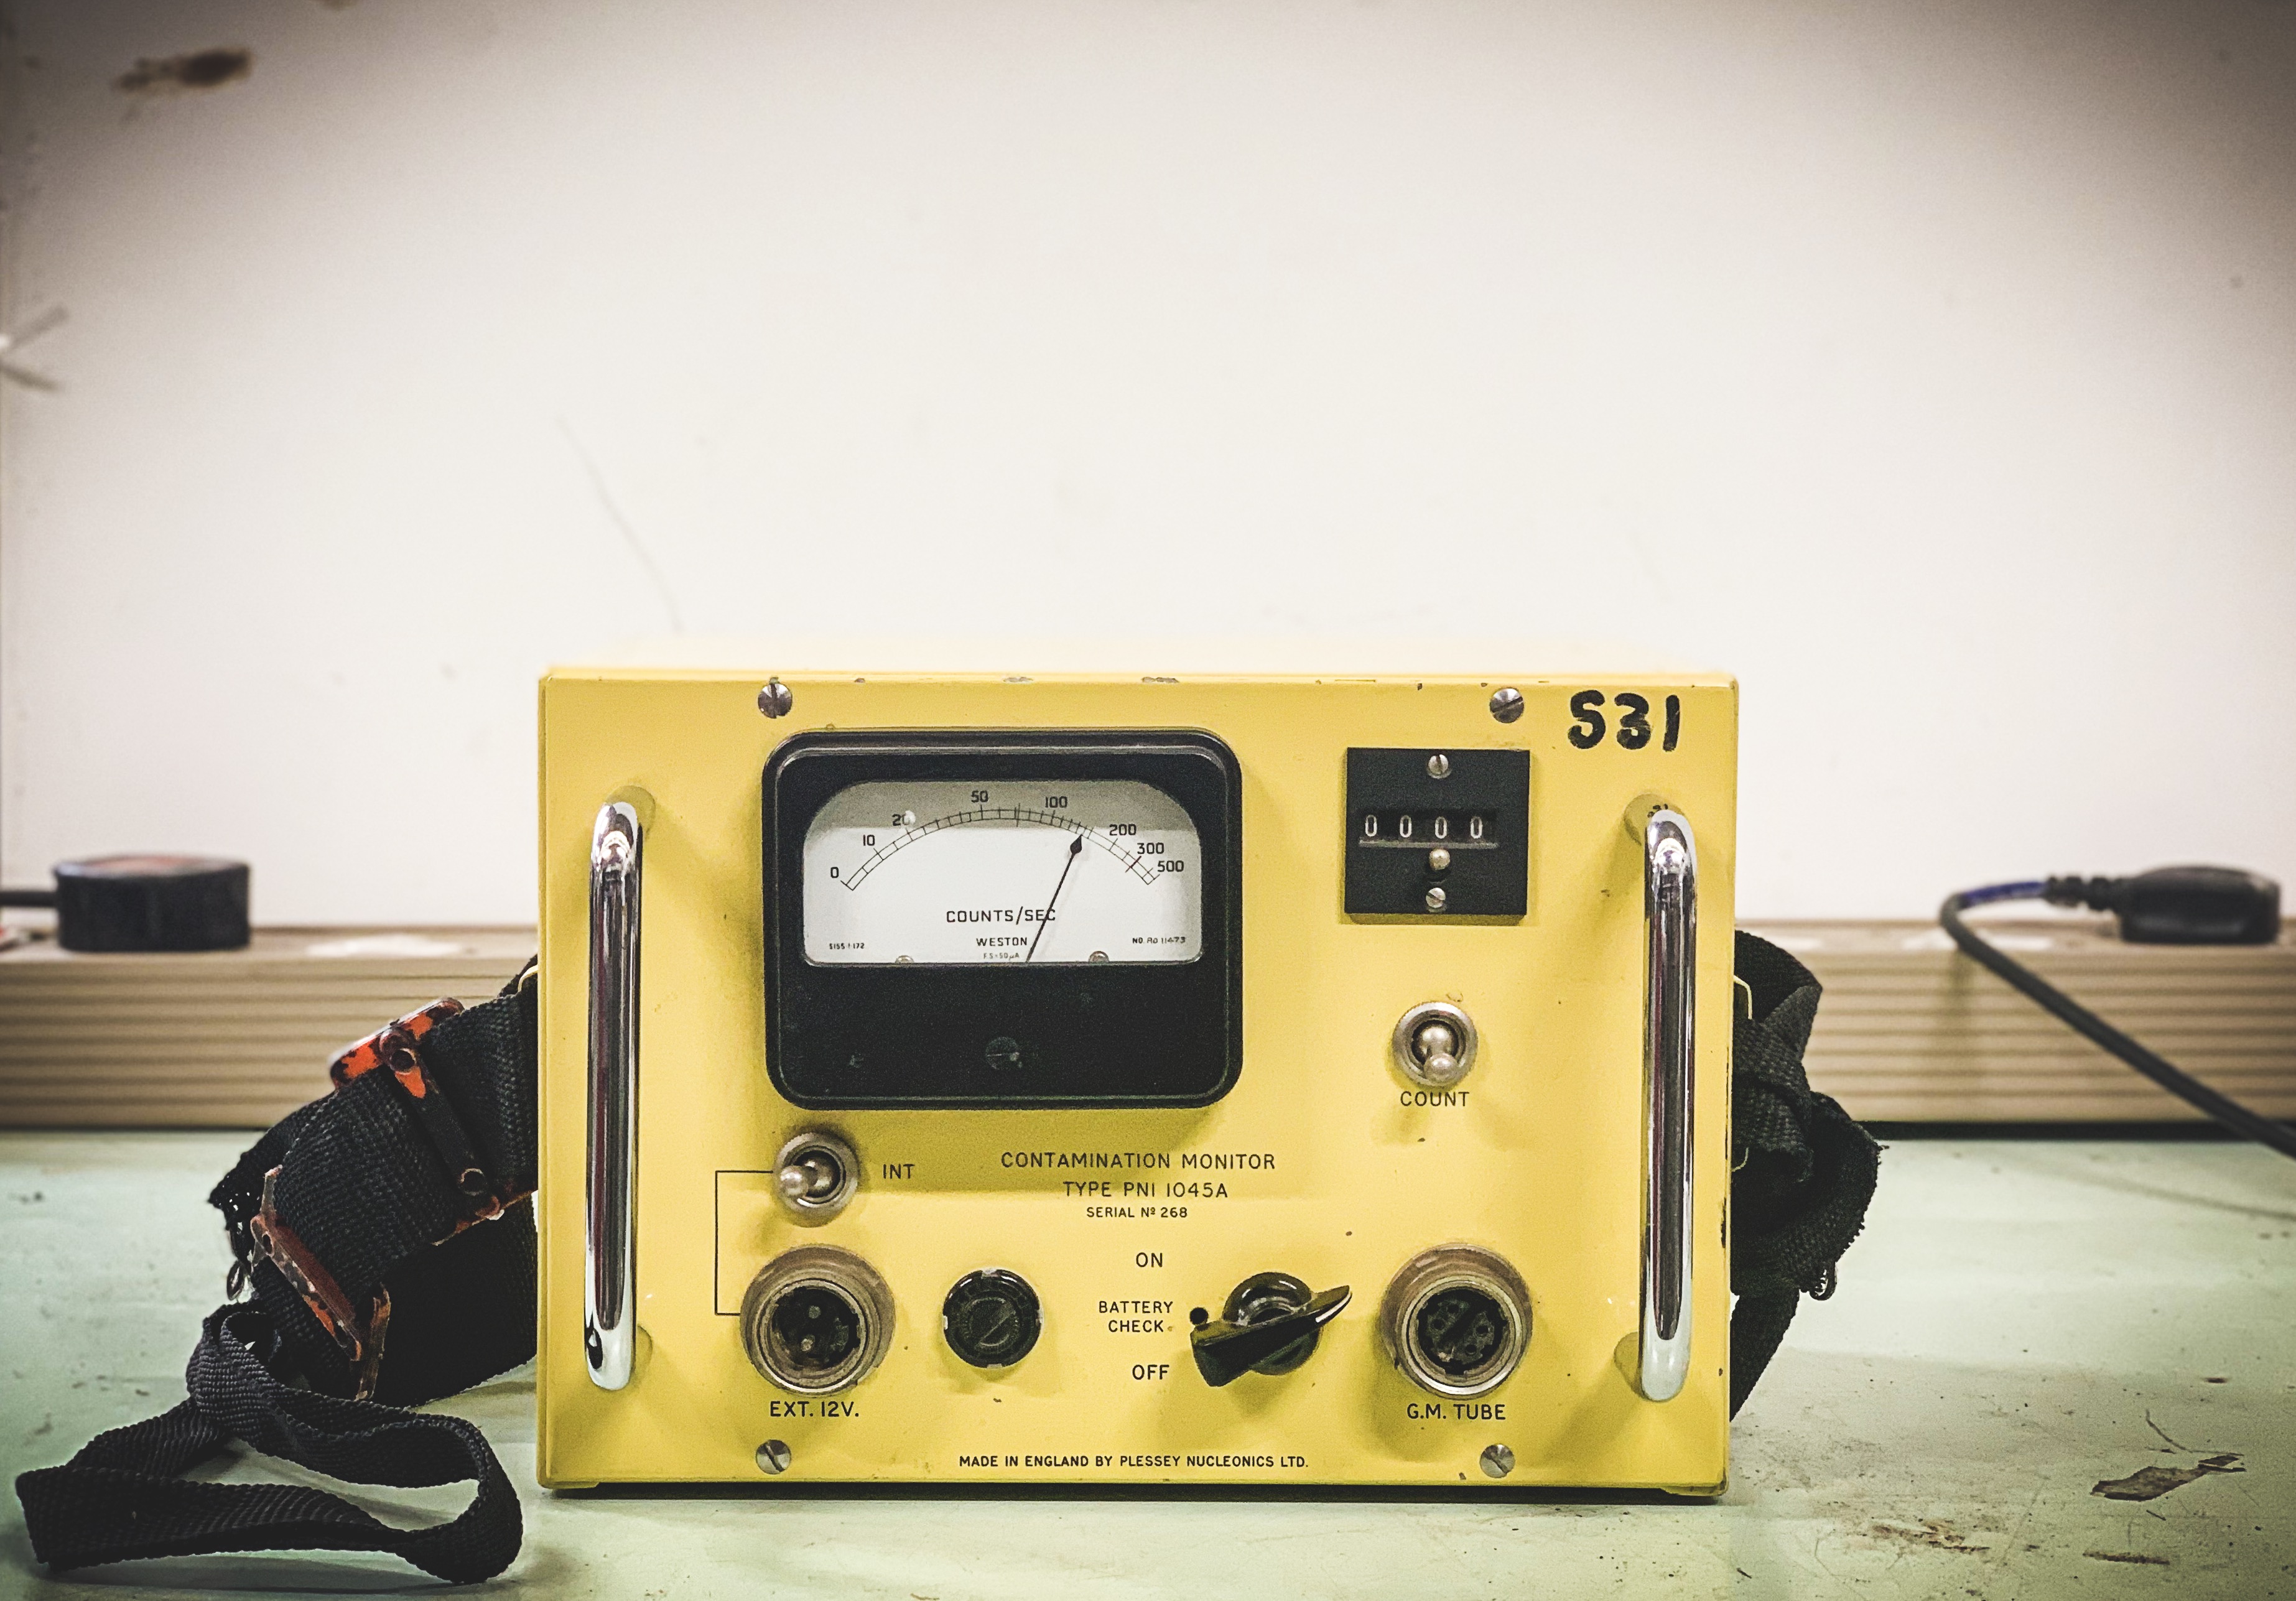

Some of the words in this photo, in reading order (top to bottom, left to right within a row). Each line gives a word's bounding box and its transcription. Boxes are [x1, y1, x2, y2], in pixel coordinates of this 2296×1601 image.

[1568, 689, 1681, 753] S31
[970, 790, 989, 804] 50
[1045, 796, 1068, 809] 100
[1108, 823, 1137, 836] 200
[863, 834, 875, 847] 10
[1136, 842, 1164, 855] 300
[830, 866, 839, 879] 0
[1157, 860, 1184, 873] 500
[976, 937, 1028, 947] WESTON
[1400, 1091, 1470, 1107] COUNT
[1001, 1151, 1170, 1169] CONTAMINATION
[1182, 1153, 1275, 1170] MONITOR
[883, 1163, 916, 1179] INT
[1062, 1181, 1112, 1197] TYPE
[1167, 1182, 1228, 1198] 1045A
[1086, 1207, 1135, 1218] SERIAL
[1160, 1207, 1188, 1218] 268
[1136, 1252, 1163, 1268] ON
[1099, 1301, 1173, 1314] BATTERY
[1108, 1319, 1164, 1333] CHECK
[1132, 1364, 1170, 1380] OFF
[769, 1401, 814, 1418] EXT.
[820, 1401, 860, 1418] 12V.
[1406, 1403, 1447, 1419] G.M.
[1452, 1403, 1507, 1421] TUBE
[959, 1455, 998, 1467] MADE
[1005, 1455, 1018, 1467] IN
[1025, 1455, 1089, 1467] ENGLAND
[1095, 1455, 1113, 1467] BY
[1120, 1455, 1181, 1467] PLESSEY
[1186, 1455, 1274, 1467] NUCLEONICS
[1280, 1455, 1309, 1468] LTD.
